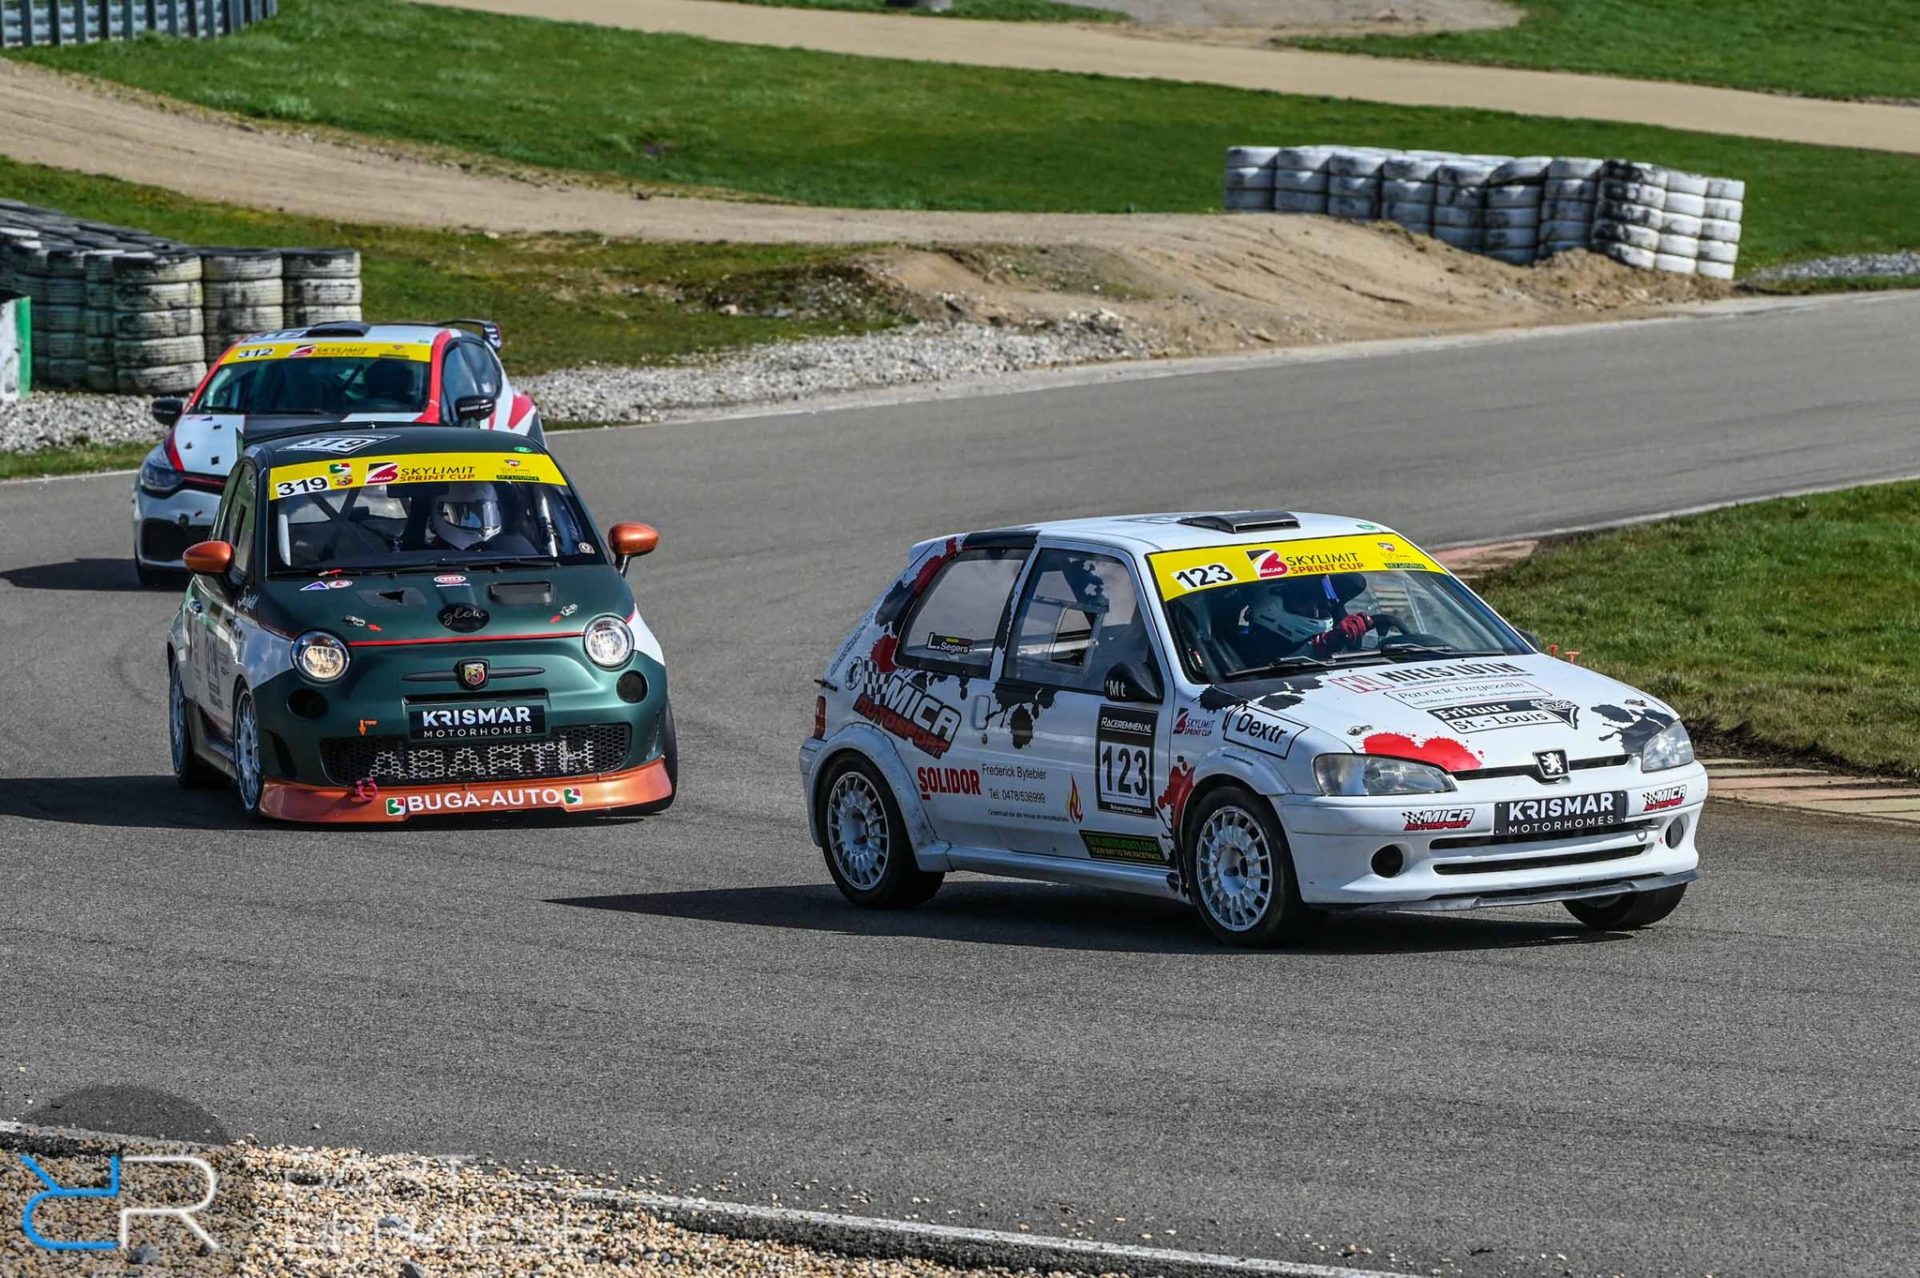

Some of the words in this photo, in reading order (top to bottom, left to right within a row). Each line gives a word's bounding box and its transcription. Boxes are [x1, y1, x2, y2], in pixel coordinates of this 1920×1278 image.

[238, 348, 273, 359] 312
[400, 474, 450, 482] SPRINT
[452, 473, 476, 481] CUP
[401, 466, 477, 476] SKYLIMIT
[278, 478, 328, 497] 319
[1286, 552, 1359, 567] SKYLIMIT
[1176, 564, 1234, 588] 123
[1290, 563, 1337, 576] SPRINT
[1340, 561, 1365, 572] CUP
[444, 606, 487, 625] glow
[940, 642, 970, 655] Segers
[1376, 667, 1455, 683] NIELS
[1398, 688, 1454, 699] Patrick
[1456, 681, 1525, 692] Degezelle
[423, 707, 531, 727] KRISMAR
[886, 676, 962, 742] MICA
[1439, 703, 1511, 720] Frituur
[1186, 718, 1216, 729] SKYLIMIT
[1452, 712, 1549, 731] St.-Louis
[424, 725, 533, 738] MOTORHOMES
[1184, 728, 1202, 736] SPRINT
[370, 737, 594, 780] ABARTH
[982, 763, 1015, 777] Frederick
[1016, 766, 1047, 781] Bytebier
[1102, 745, 1148, 797] 123
[918, 766, 982, 796] SOLIDOR
[408, 789, 562, 812] BUGA-AUTO
[1655, 785, 1687, 802] MICA
[1509, 792, 1614, 820] KRISMAR
[1423, 808, 1475, 823] MICA
[1509, 814, 1614, 834] MOTORHOMES
[1404, 820, 1470, 831] AUTOSPORT
